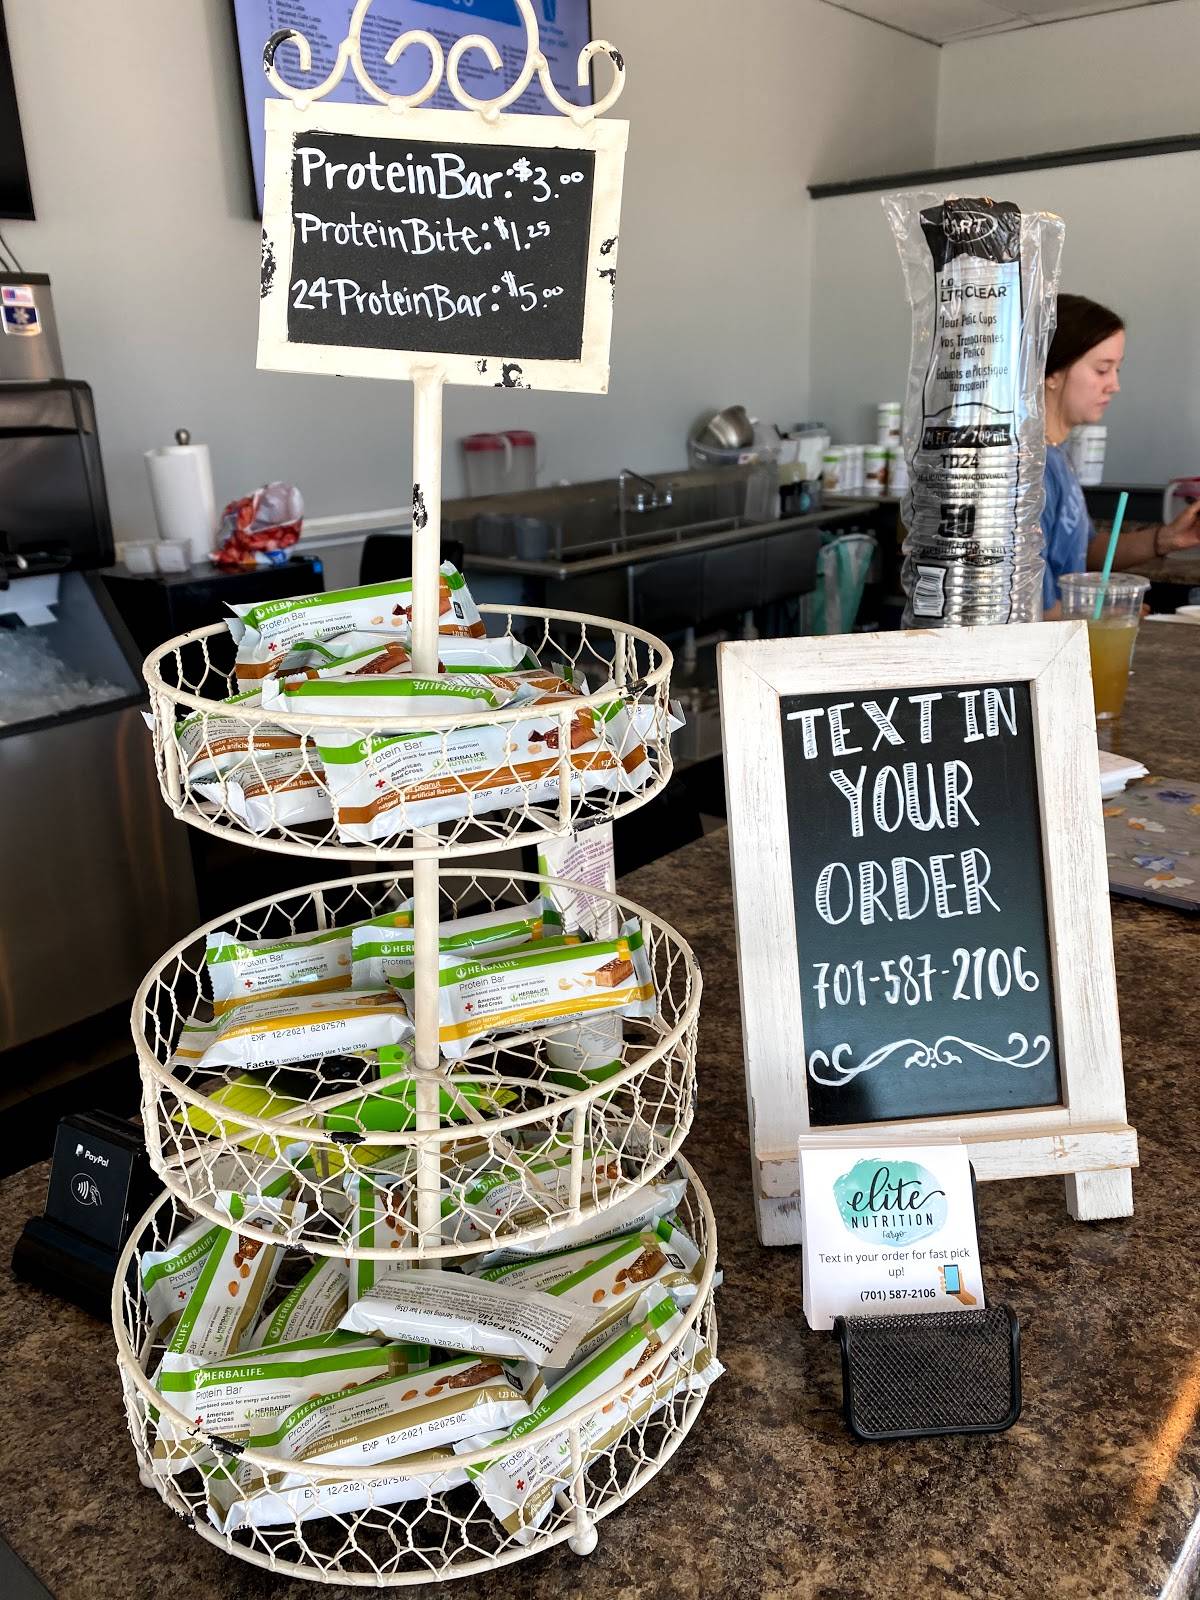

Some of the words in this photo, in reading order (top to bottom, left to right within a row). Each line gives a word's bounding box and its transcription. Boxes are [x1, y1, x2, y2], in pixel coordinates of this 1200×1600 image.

[965, 286, 1006, 298] CLEAR
[941, 453, 979, 468] TD24
[938, 504, 975, 538] 50
[259, 618, 290, 631] Protein
[291, 611, 306, 621] Bar
[281, 631, 304, 643] American
[787, 692, 942, 760] TEXT
[958, 687, 1018, 744] IN
[364, 745, 401, 767] Potein
[403, 741, 423, 751] Bar
[403, 753, 417, 761] snack
[457, 742, 480, 750] nutrition
[390, 763, 422, 777] American
[391, 773, 404, 782] Red
[405, 768, 424, 776] Cross
[411, 790, 436, 800] artificial
[437, 787, 456, 795] flavors
[474, 791, 492, 800] EXP
[830, 760, 981, 838] YOUR
[815, 847, 1001, 926] ORDER
[269, 954, 284, 963] Bar
[297, 964, 328, 973] HERBALIFE
[459, 978, 488, 991] Protein
[491, 975, 506, 985] Bar
[813, 946, 1040, 1010] 701-587-2106
[477, 995, 502, 1004] American
[518, 987, 548, 998] HERBALIFE
[519, 991, 550, 1001] NUTRITION
[482, 1015, 501, 1024] lemon
[251, 1033, 266, 1042] EXP
[272, 1027, 306, 1039] 12/2021
[247, 1059, 275, 1070] Facts
[303, 1051, 324, 1060] Serving
[342, 1045, 352, 1053] bar
[84, 1150, 109, 1167] PayPal
[847, 1167, 945, 1212] elite
[852, 1213, 933, 1228] NUTRITION
[594, 1231, 612, 1240] Serving
[625, 1220, 633, 1228] bar
[819, 1254, 841, 1263] Text
[844, 1253, 853, 1263] in
[855, 1254, 878, 1264] your
[882, 1250, 909, 1261] order
[912, 1250, 926, 1260] for
[929, 1249, 948, 1259] fast
[951, 1248, 970, 1262] pick
[169, 1266, 198, 1284] Protein
[512, 1270, 526, 1279] Bar
[888, 1267, 905, 1279] up!
[860, 1290, 886, 1301] (701)
[889, 1288, 936, 1299] 587-2106
[283, 1312, 300, 1341] Protein
[297, 1298, 308, 1310] Bar
[434, 1309, 454, 1319] Serving
[497, 1315, 521, 1327] Calories
[477, 1319, 506, 1331] Facts
[434, 1339, 465, 1349] 12/2021
[508, 1326, 553, 1354] Nutrition
[581, 1331, 608, 1352] 12/2021
[196, 1388, 223, 1401] Protein
[226, 1385, 243, 1396] Bar
[244, 1397, 260, 1405] energy
[207, 1410, 234, 1419] American
[351, 1402, 389, 1419] HERBALIFE
[288, 1413, 317, 1440] Protein
[320, 1405, 336, 1414] Bar
[339, 1436, 357, 1445] flavors
[362, 1440, 379, 1452] EXP
[385, 1426, 424, 1446] 12/2021
